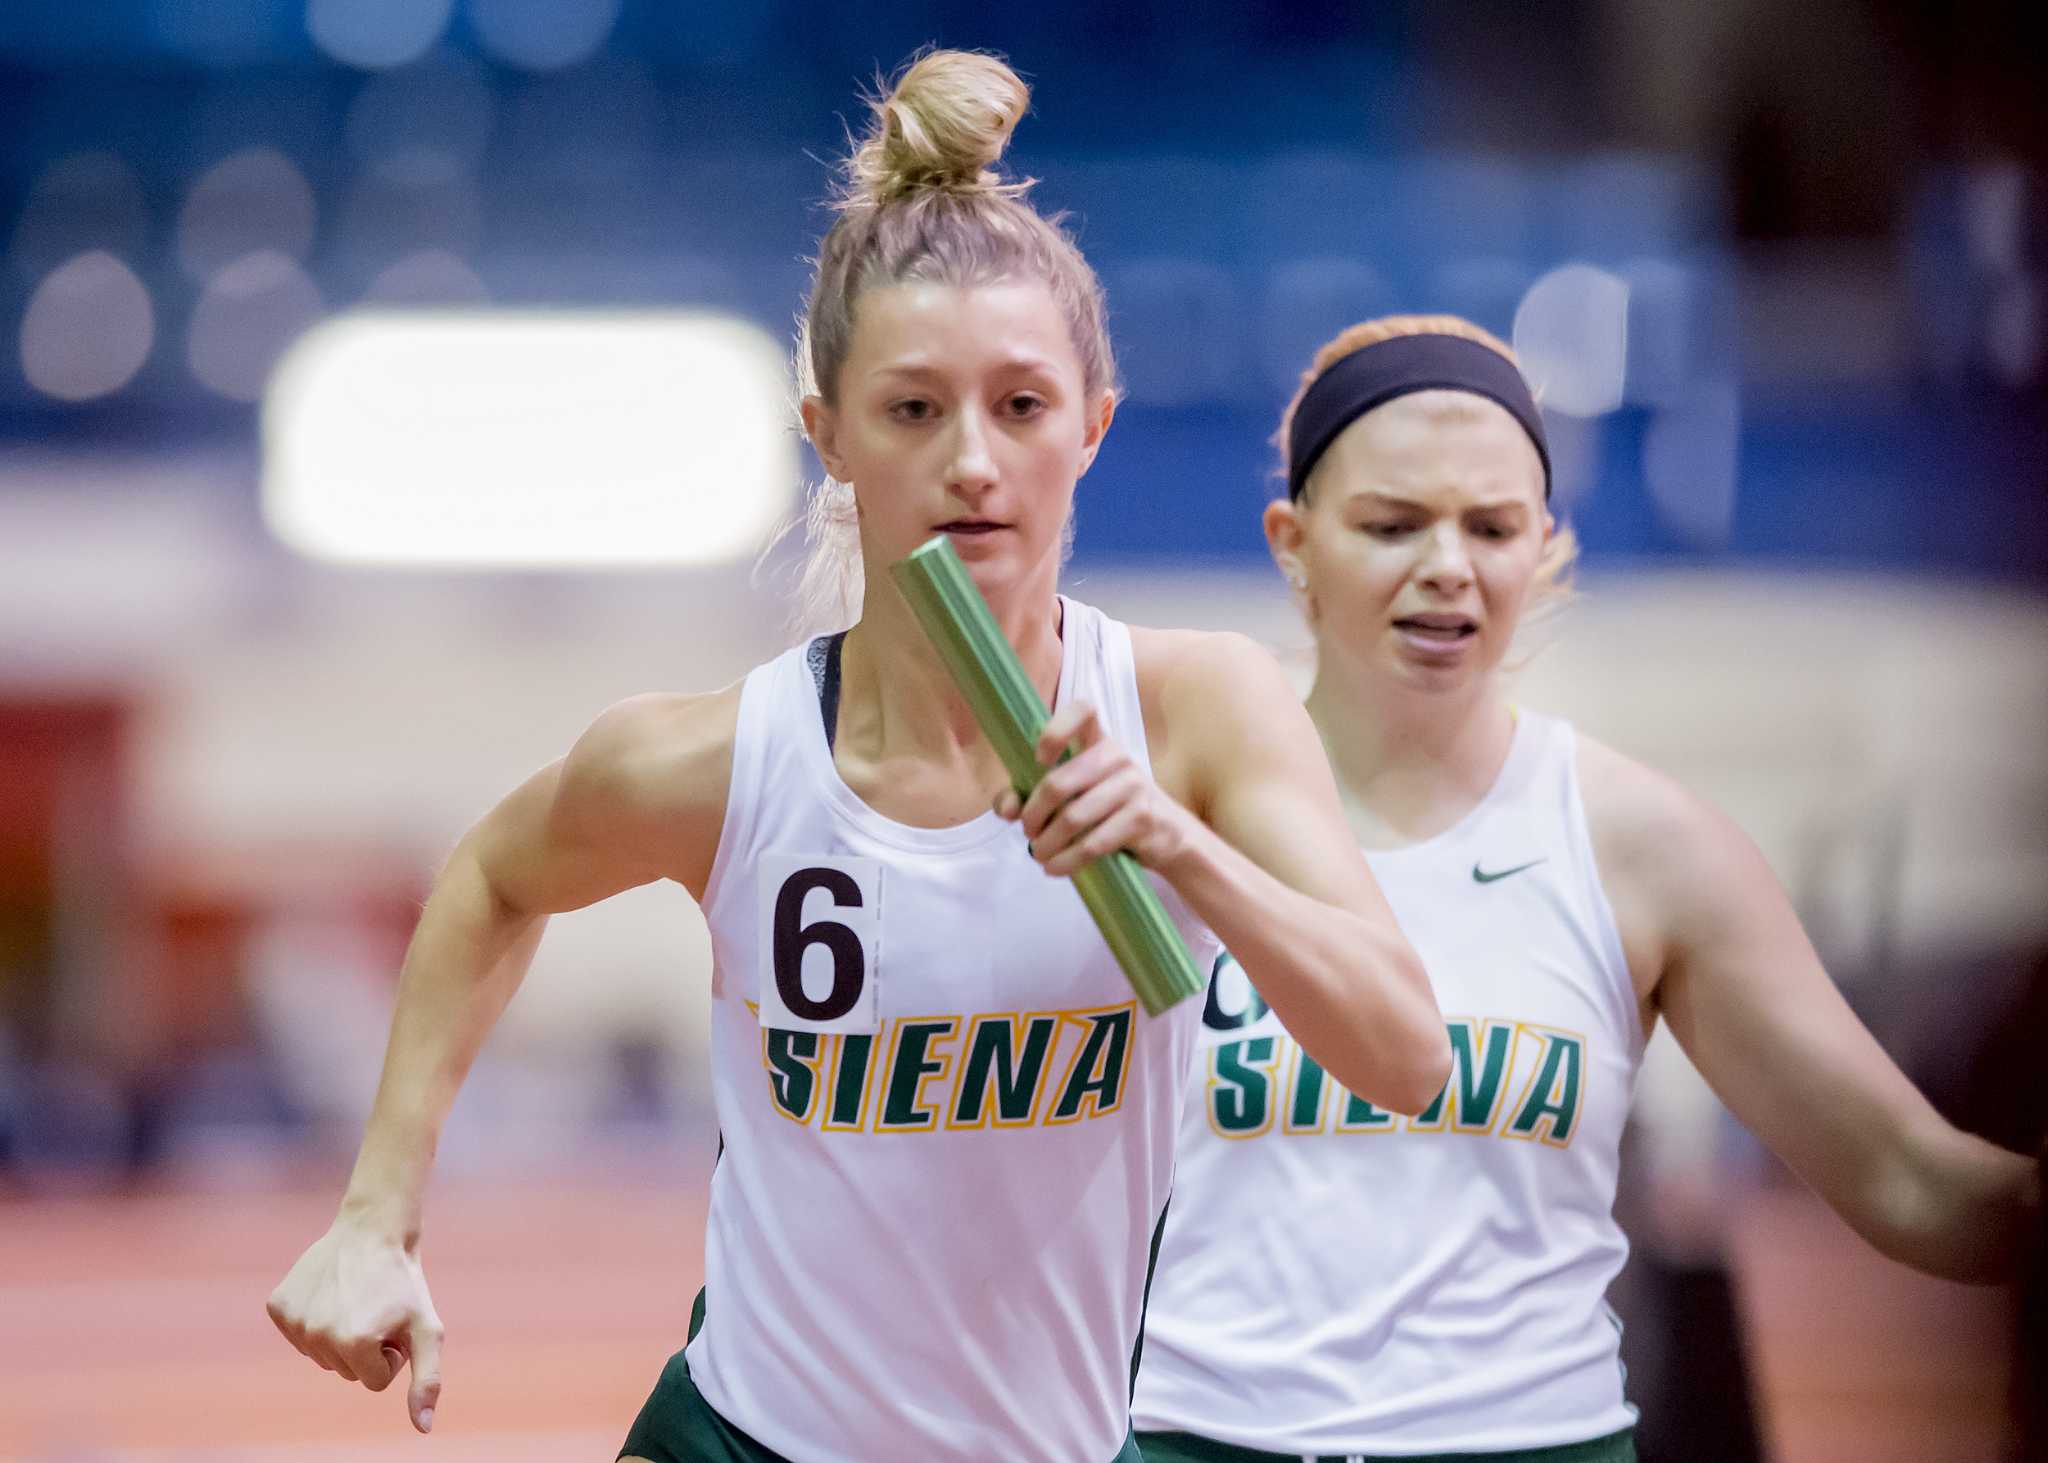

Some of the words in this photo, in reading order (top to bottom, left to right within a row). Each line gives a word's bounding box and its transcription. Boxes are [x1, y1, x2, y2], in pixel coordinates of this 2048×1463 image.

[773, 867, 865, 1022] 6
[763, 1000, 1137, 1133] SIENA
[1206, 1017, 1587, 1149] SINA
